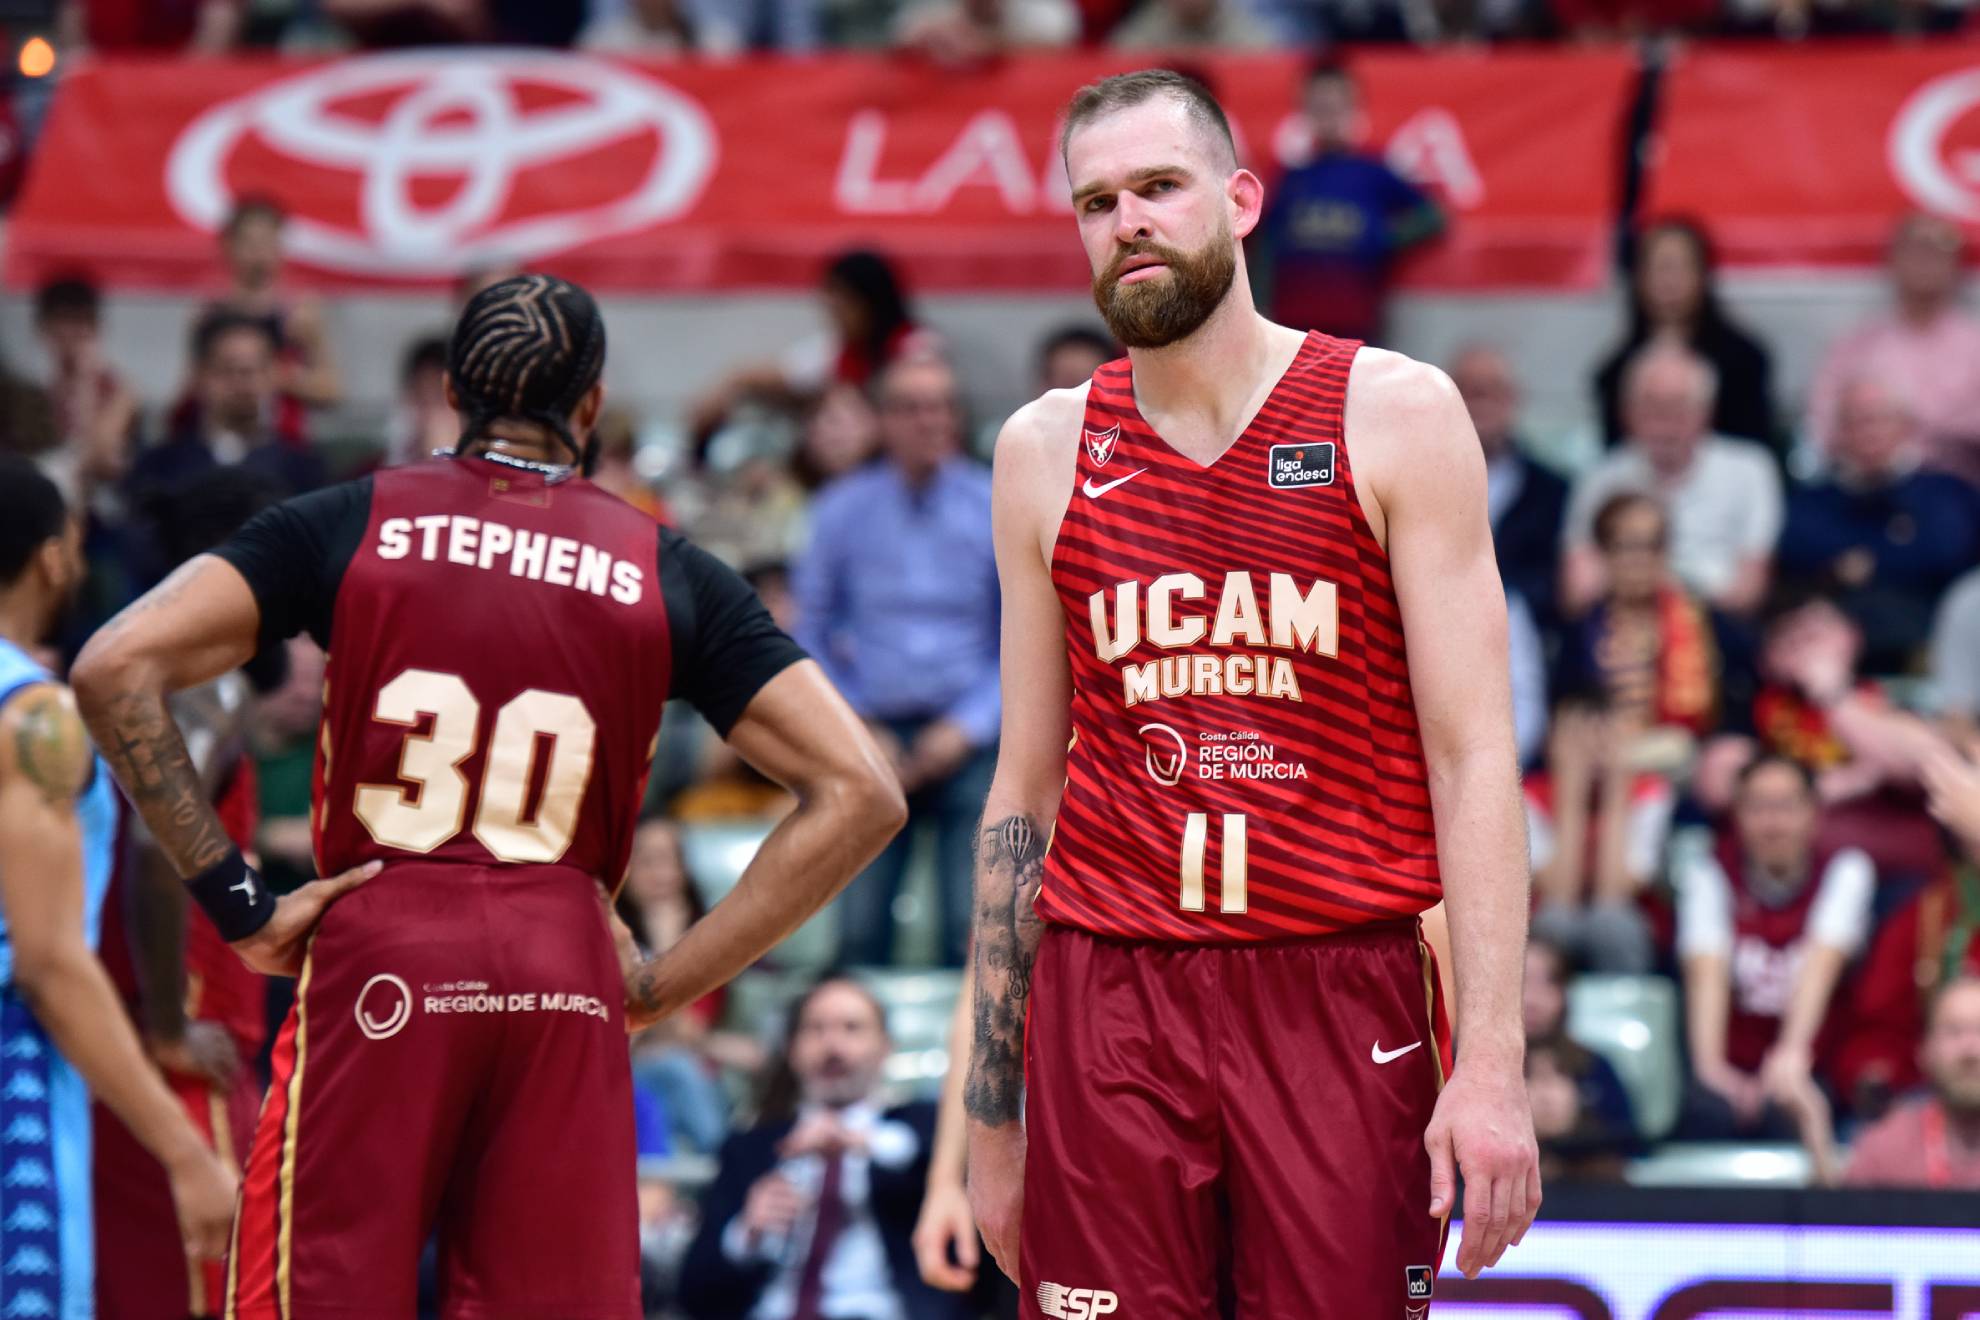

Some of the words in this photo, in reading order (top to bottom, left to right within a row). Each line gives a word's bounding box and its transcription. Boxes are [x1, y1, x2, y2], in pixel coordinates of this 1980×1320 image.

[1275, 469, 1329, 482] endesa
[1276, 458, 1302, 472] liga
[376, 514, 644, 606] STEPHENS
[1088, 570, 1340, 664] UCAM
[1122, 653, 1304, 709] MURCIA
[1199, 732, 1228, 741] Costa
[1199, 741, 1275, 762] REGIÓN
[352, 667, 597, 864] 30
[1199, 763, 1225, 780] DE
[1230, 762, 1309, 780] MURCIA
[1180, 812, 1248, 915] 11
[423, 991, 504, 1014] REGIÓN
[507, 994, 536, 1012] DE
[1410, 1278, 1427, 1294] acb
[1036, 1280, 1119, 1320] ESP
